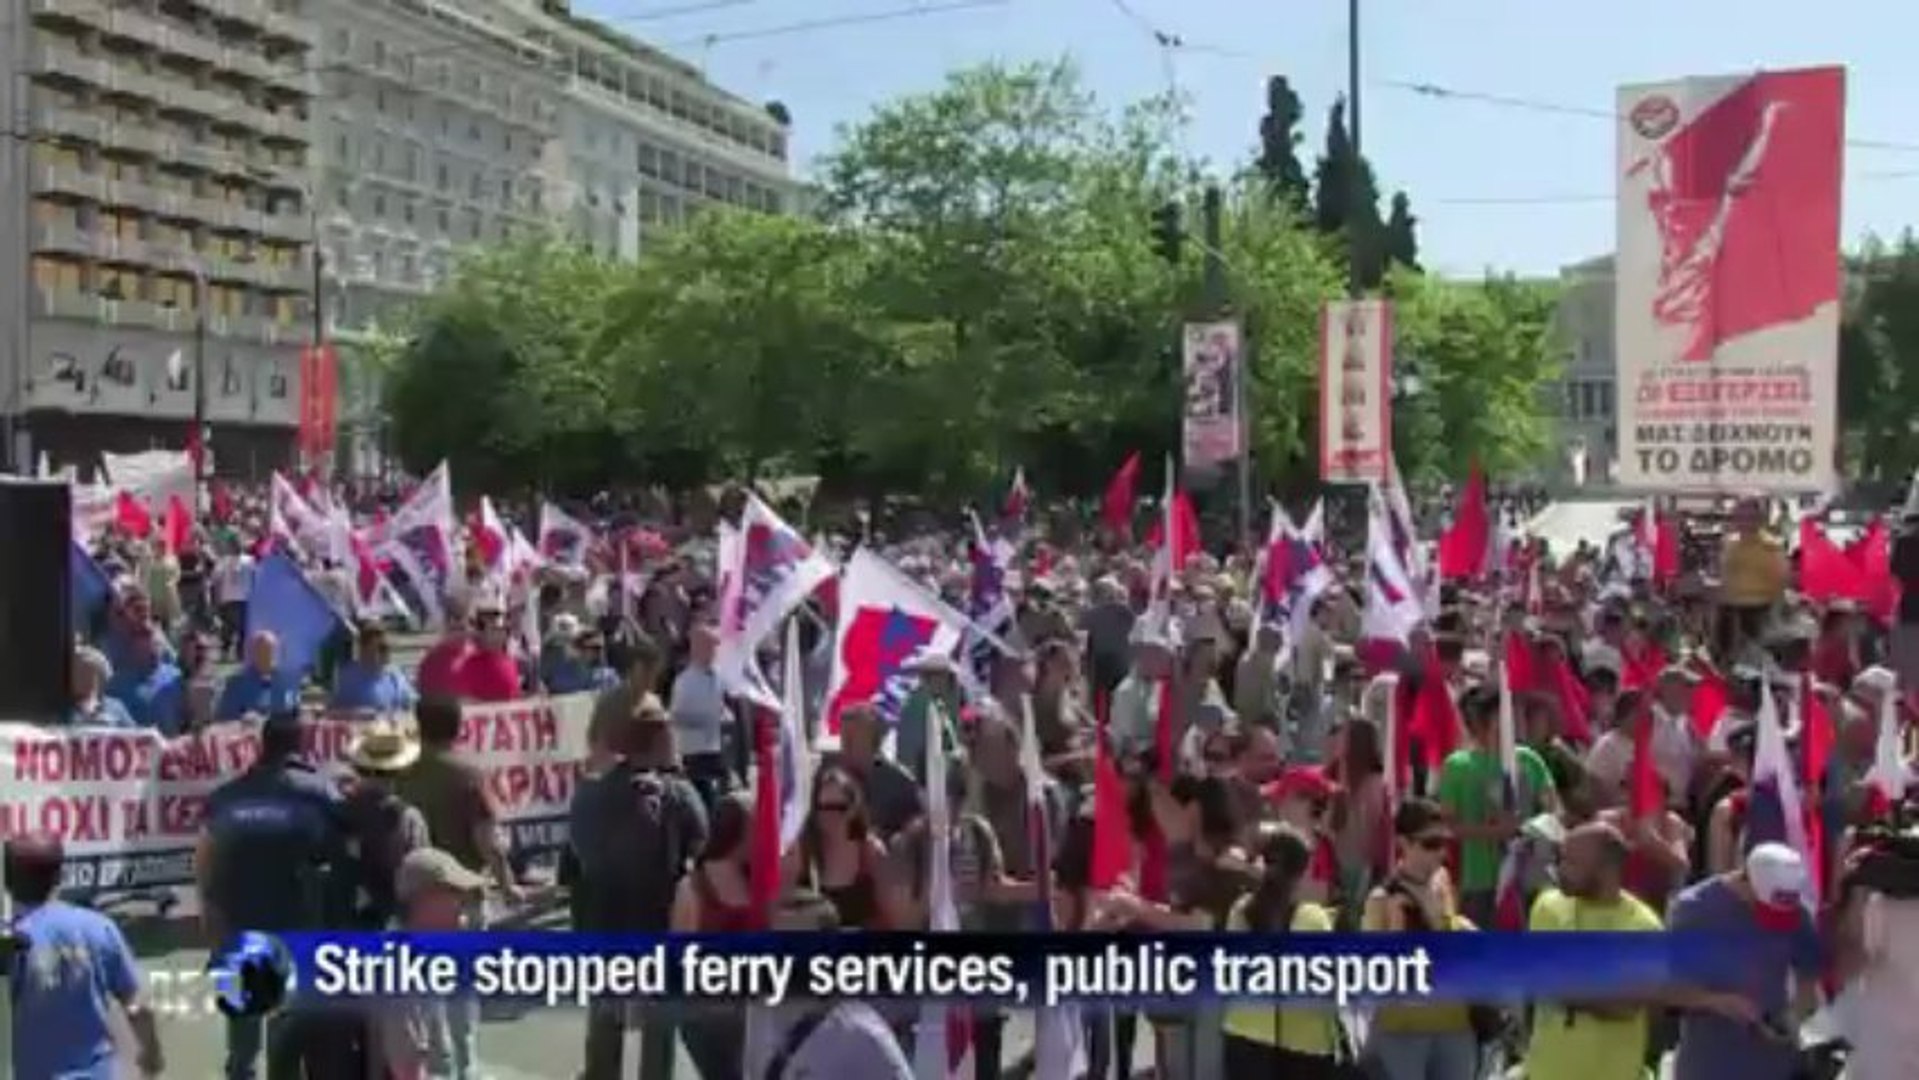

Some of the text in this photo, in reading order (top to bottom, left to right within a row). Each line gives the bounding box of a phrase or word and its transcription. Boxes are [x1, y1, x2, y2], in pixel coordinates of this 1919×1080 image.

[1635, 423, 1685, 443] ΜΑΣ
[1635, 447, 1813, 475] ΤΟ ΔΡΟΜΟ
[14, 736, 152, 782] ΝΟΜΟΣ
[41, 796, 109, 840] ΟΧΙ
